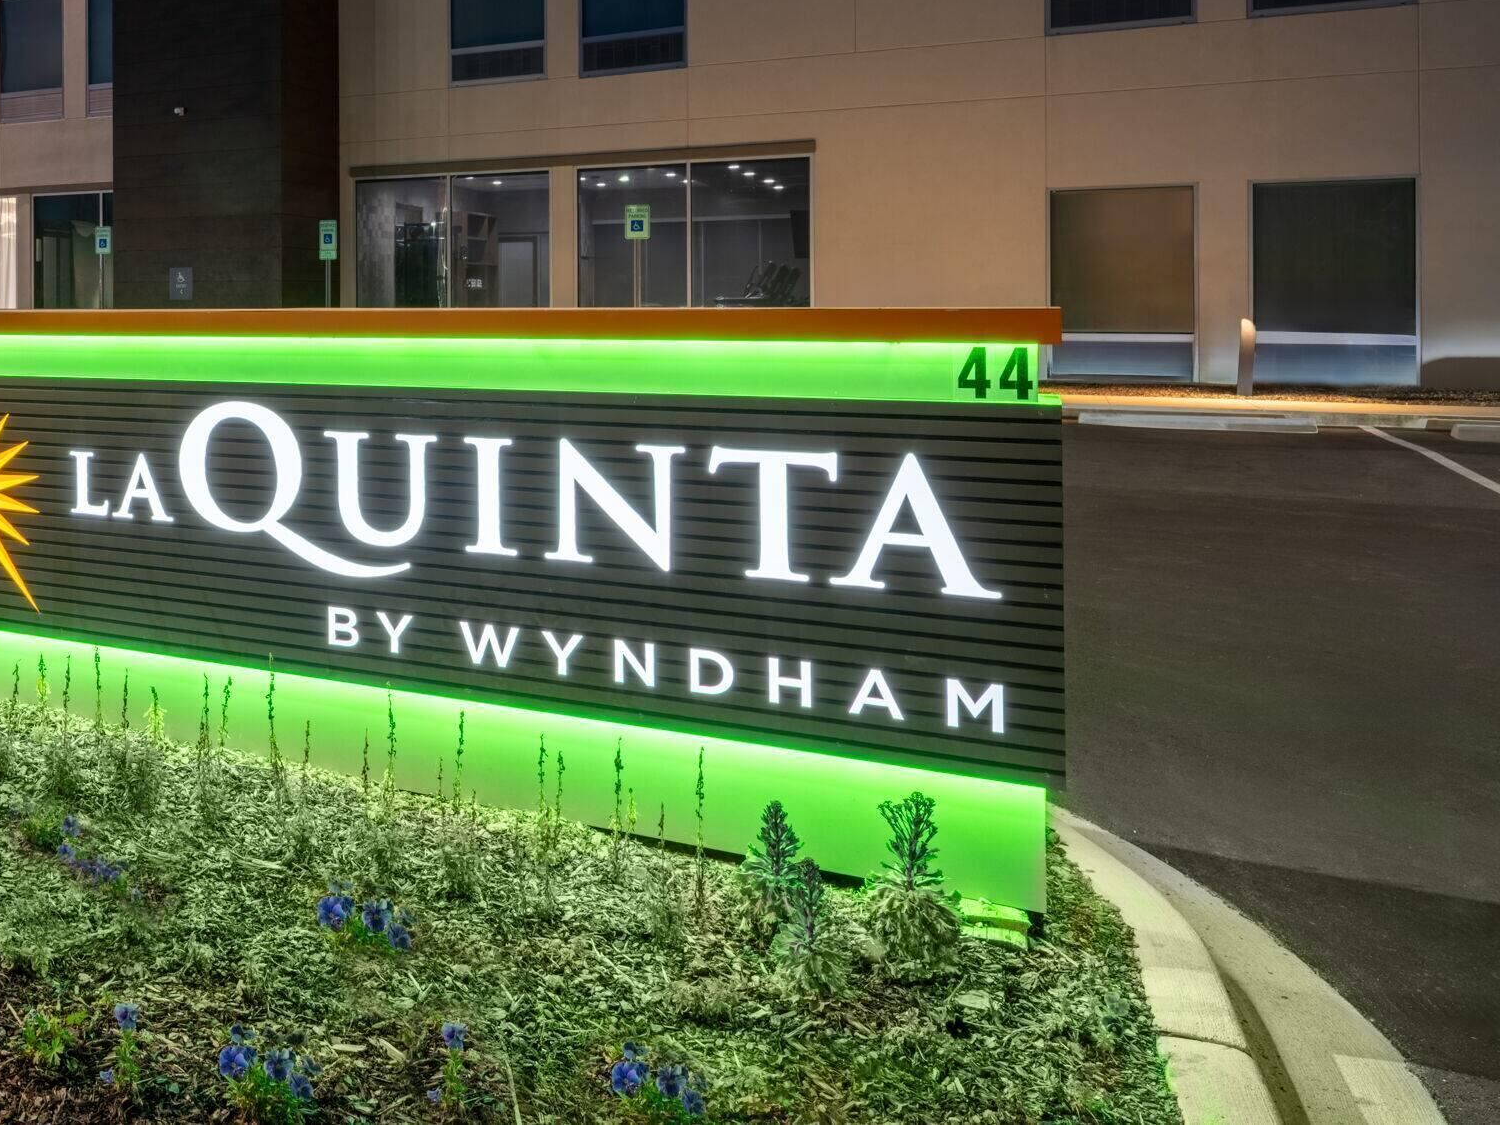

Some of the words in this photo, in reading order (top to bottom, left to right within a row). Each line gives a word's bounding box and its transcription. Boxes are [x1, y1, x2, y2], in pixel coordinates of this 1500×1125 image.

[958, 346, 1034, 400] 44
[69, 450, 175, 523] LA
[178, 400, 1003, 600] QUINTA
[327, 605, 413, 654] BY
[459, 620, 1005, 734] WYNDHAM
